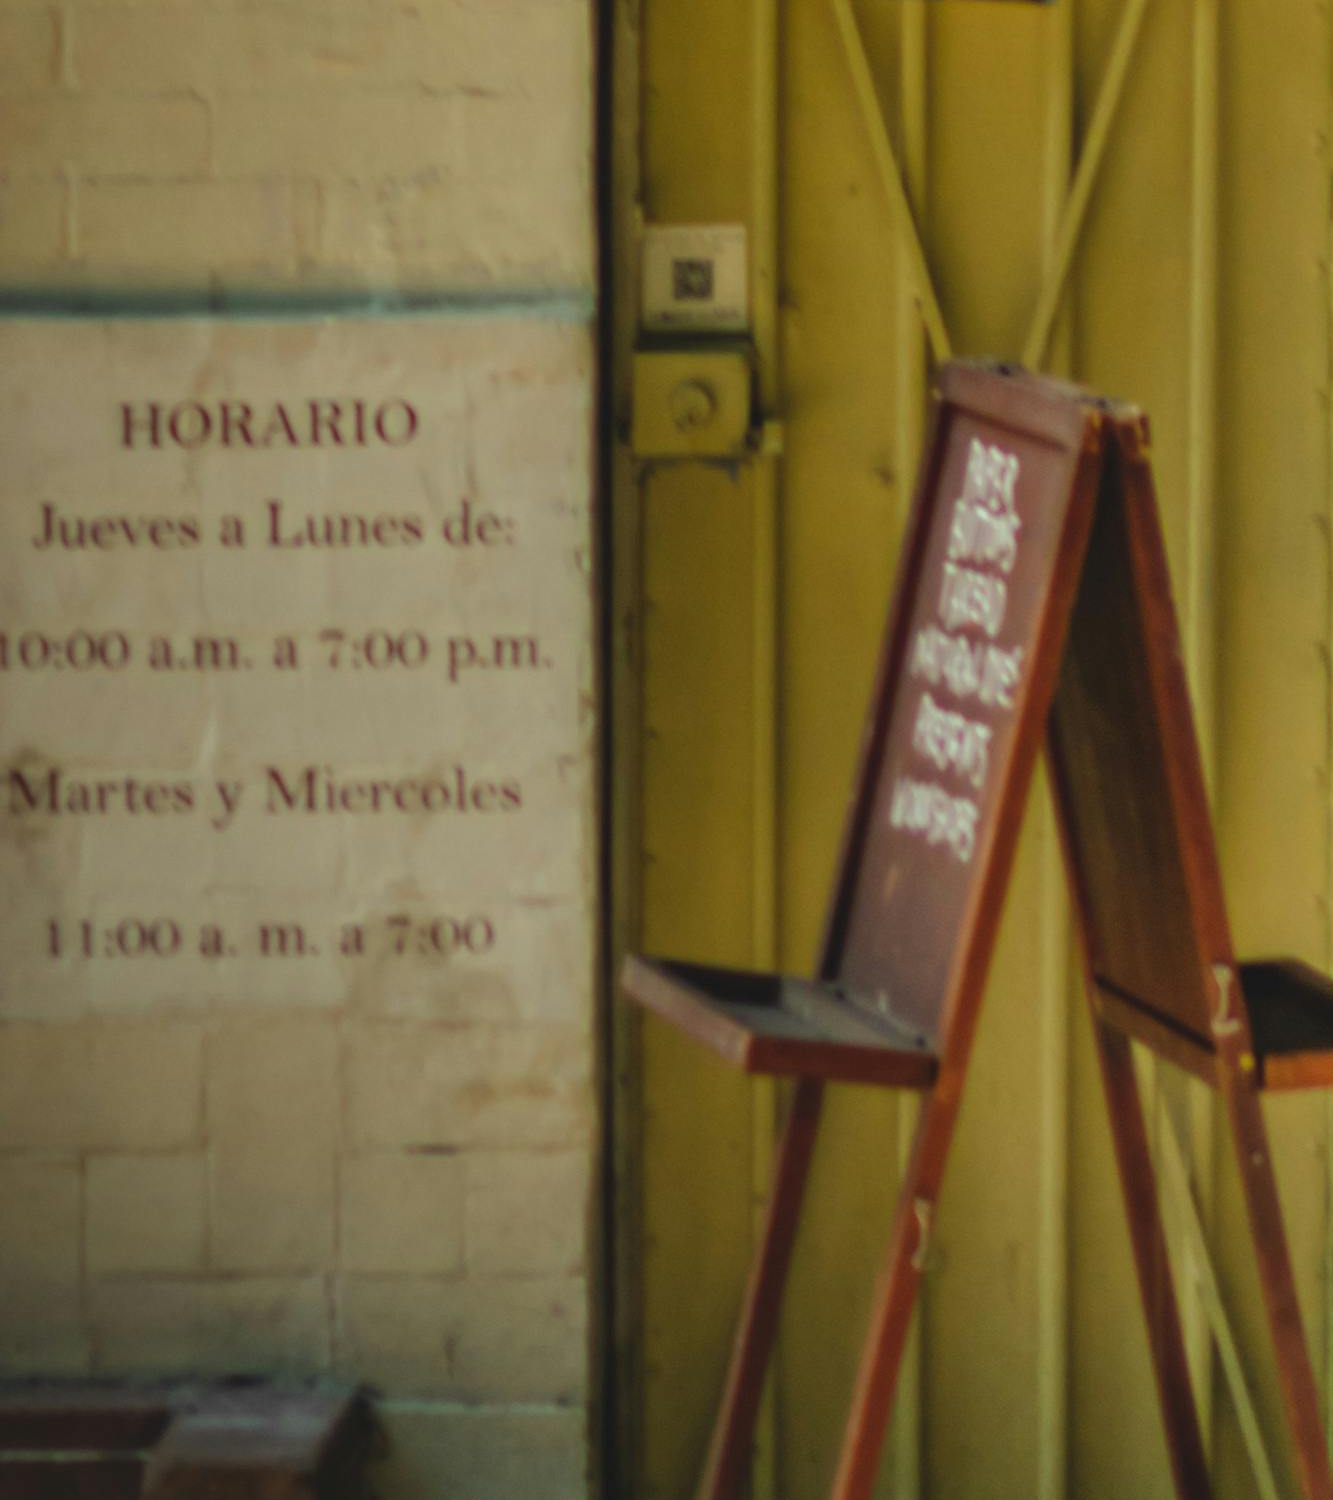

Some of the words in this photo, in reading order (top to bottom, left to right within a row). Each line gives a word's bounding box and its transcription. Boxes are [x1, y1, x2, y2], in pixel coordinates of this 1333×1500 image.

[117, 400, 420, 450] HORARIO
[31, 501, 201, 551] Jueves
[218, 514, 245, 548] a
[265, 501, 424, 549] Lunes
[441, 501, 516, 547] de:
[0, 628, 131, 671] 10:00
[147, 636, 252, 672] a.m.
[272, 636, 297, 671] a
[318, 630, 429, 670] 7:00
[448, 634, 554, 683] p.m.
[7, 767, 195, 816] Martes
[209, 780, 242, 833] y
[339, 920, 364, 956] a
[384, 914, 496, 956] 7:00
